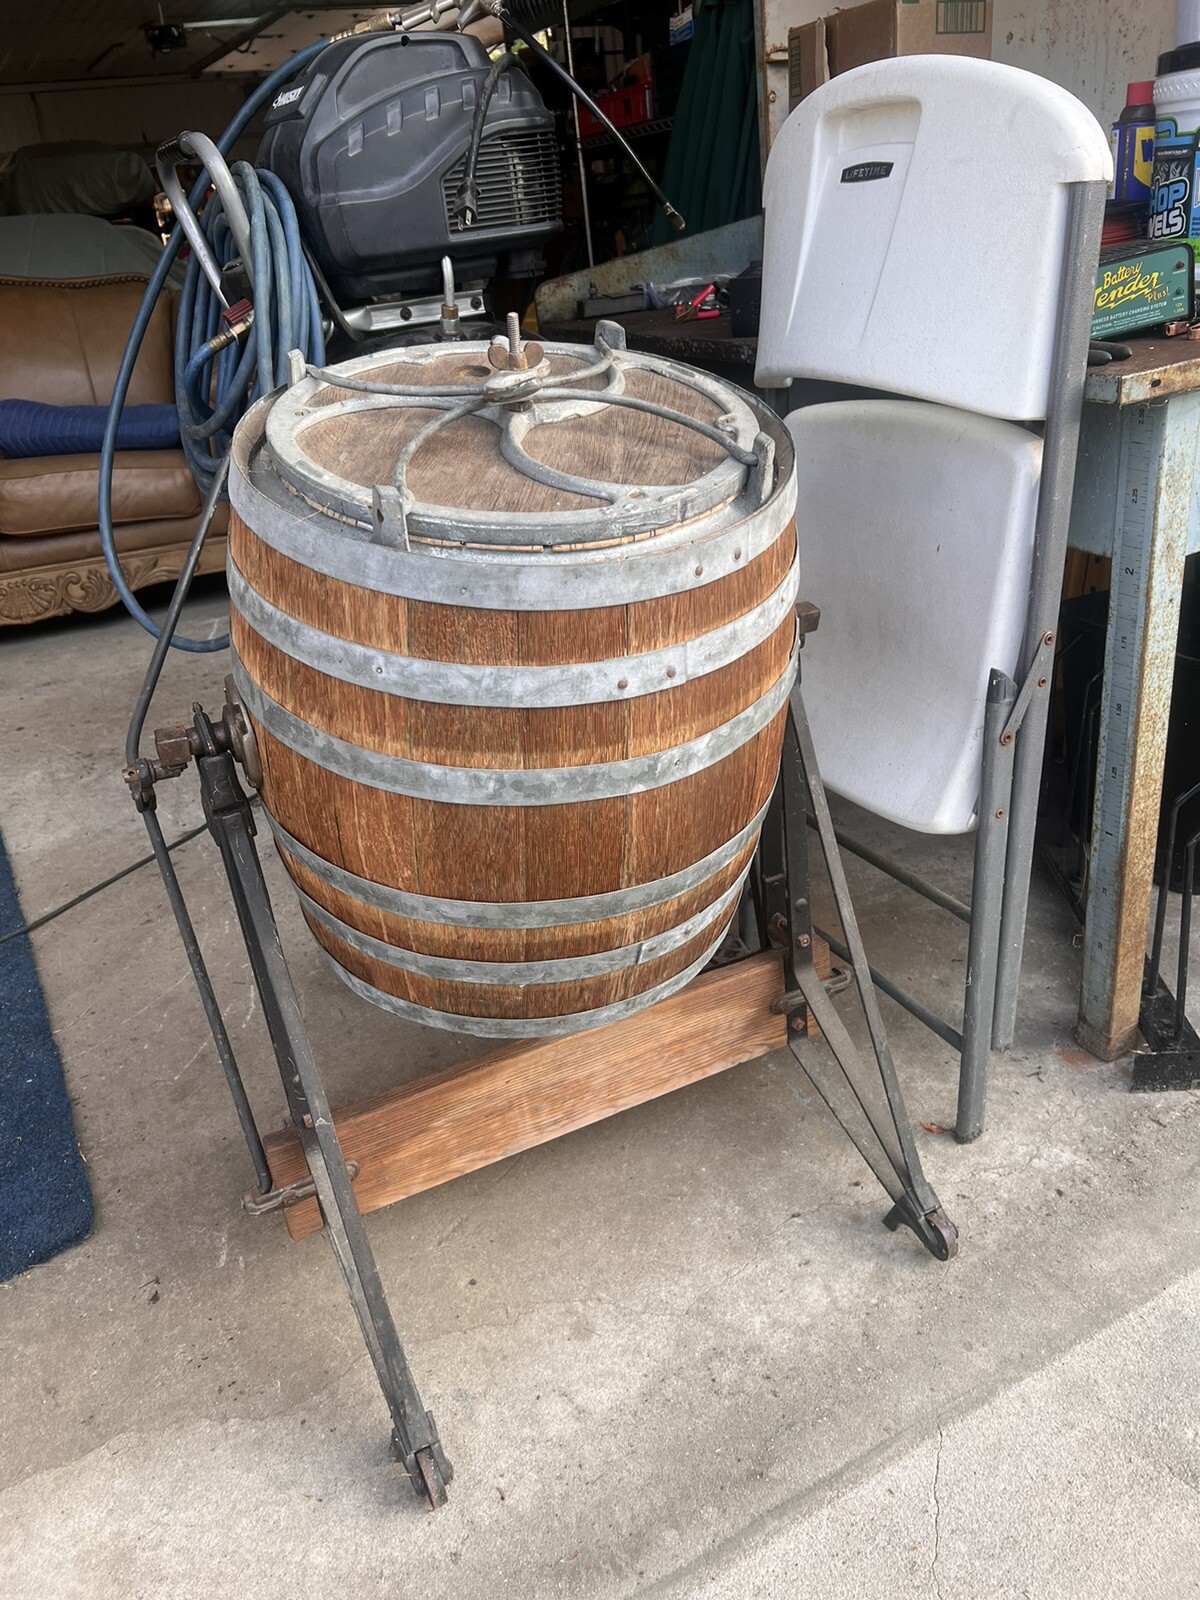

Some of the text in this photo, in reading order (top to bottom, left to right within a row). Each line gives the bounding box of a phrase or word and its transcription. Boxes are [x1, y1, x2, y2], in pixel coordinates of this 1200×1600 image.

[844, 165, 888, 180] LIFETIME
[1150, 181, 1186, 214] HOP
[1103, 261, 1144, 290] Battery
[1131, 487, 1139, 505] 2.25
[1124, 566, 1135, 576] 2
[1120, 635, 1128, 650] 1.75
[1115, 702, 1123, 717] 1.50
[1110, 766, 1118, 780] 1.25
